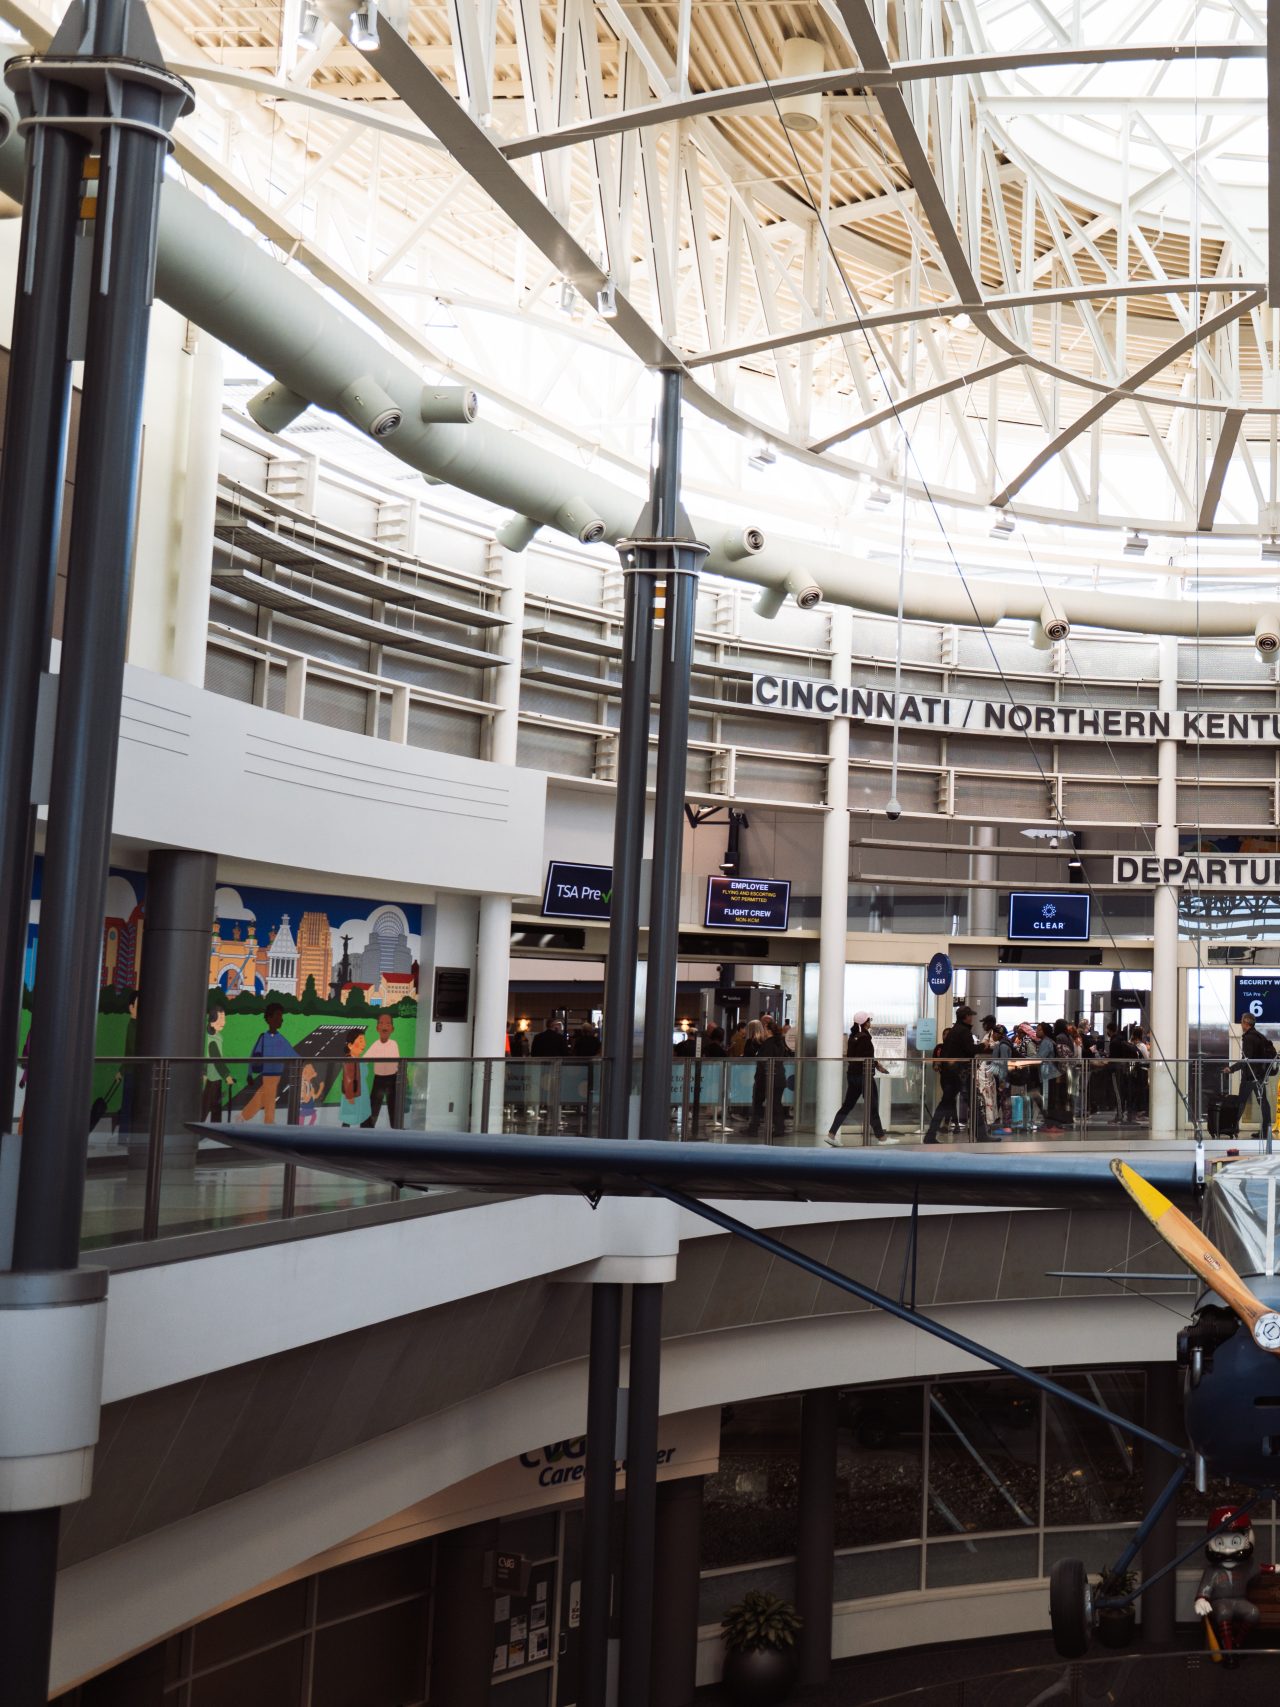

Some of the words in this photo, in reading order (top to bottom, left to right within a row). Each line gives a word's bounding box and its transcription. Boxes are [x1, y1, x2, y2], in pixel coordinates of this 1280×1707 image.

[756, 676, 950, 725] CINCINNATI
[985, 703, 1170, 737] NORTHERN
[557, 884, 579, 899] TSA
[581, 886, 602, 901] Pre
[731, 882, 769, 891] EMPLOYEE
[724, 908, 750, 916] FLIGHT
[750, 910, 772, 918] CREW
[1033, 922, 1064, 930] CLEAR
[1249, 1000, 1264, 1018] 6
[538, 1464, 585, 1487] Care
